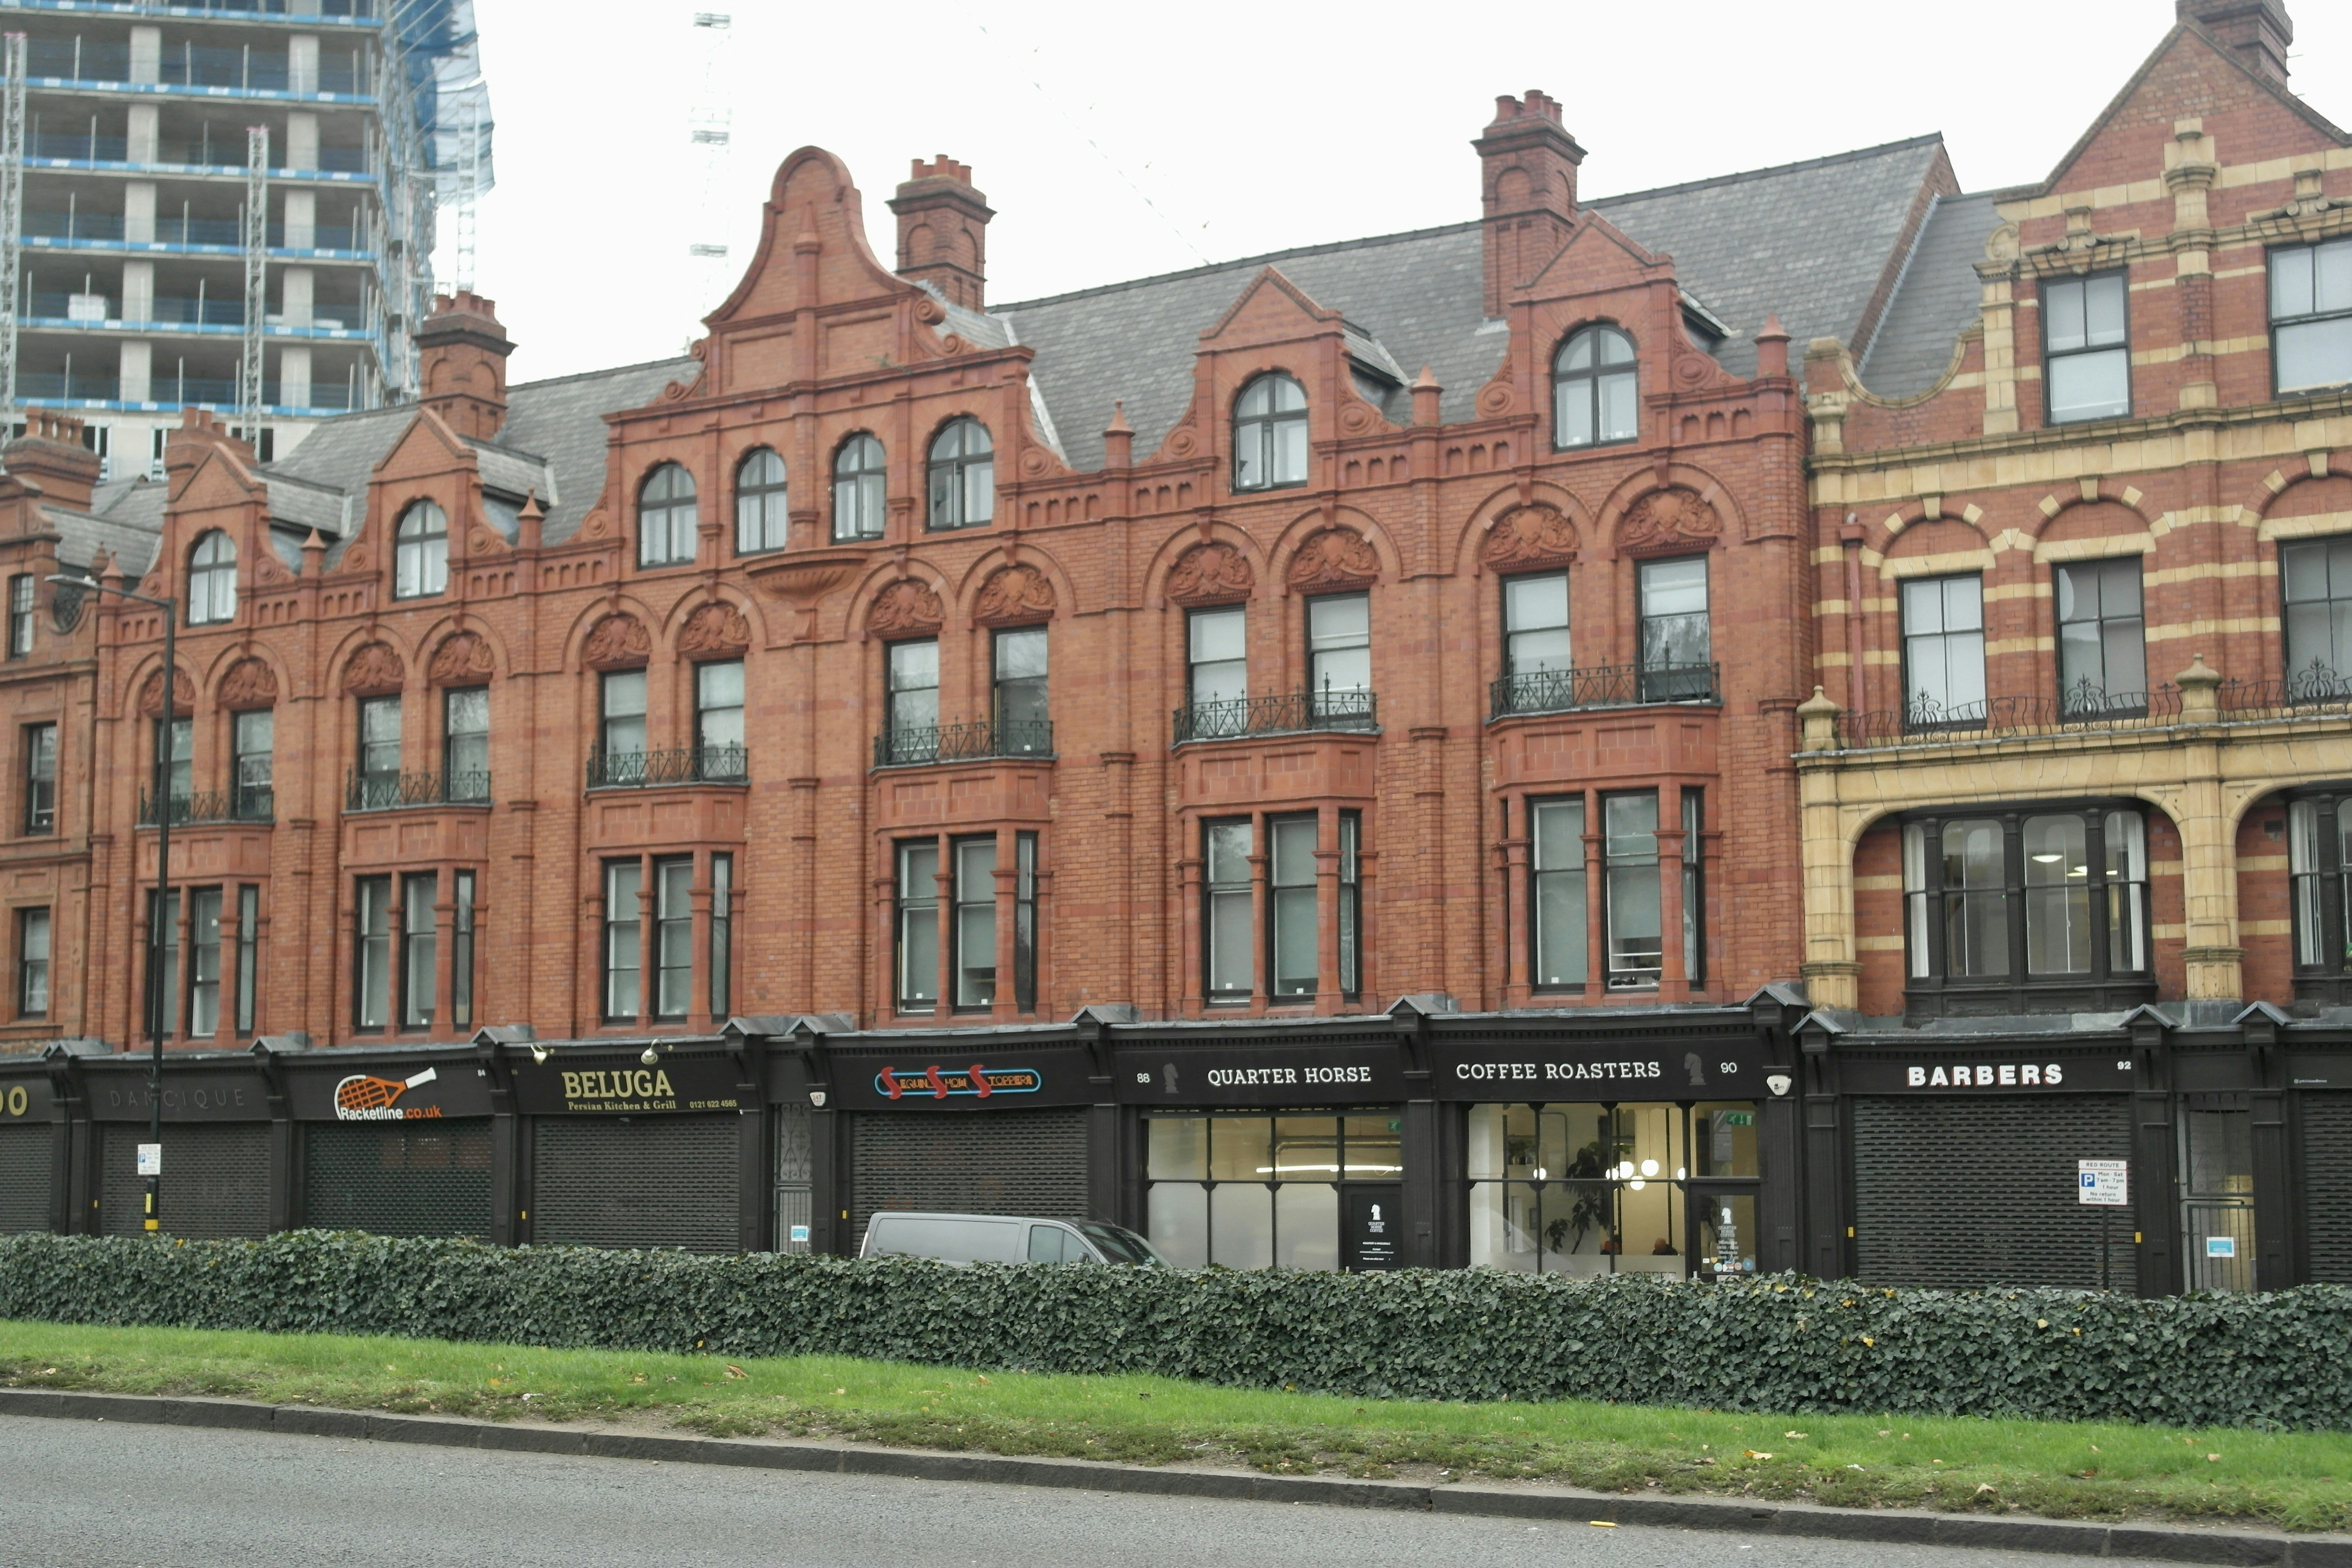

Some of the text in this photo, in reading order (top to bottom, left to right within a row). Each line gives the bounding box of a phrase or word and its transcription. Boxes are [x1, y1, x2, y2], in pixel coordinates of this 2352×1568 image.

[1456, 1062, 1660, 1079] COFFEE ROASTERS
[1721, 1062, 1737, 1073] 90
[2117, 1061, 2131, 1070] 92
[1137, 1073, 1150, 1083] 88
[1208, 1066, 1371, 1086] QUARTER HORSE
[1907, 1064, 2063, 1087] BARBERS
[561, 1069, 674, 1098] BELUGA
[568, 1100, 676, 1110] Persian Kitchen & Grill
[340, 1105, 442, 1120] Racketline.co.uk
[2084, 1175, 2093, 1186] P
